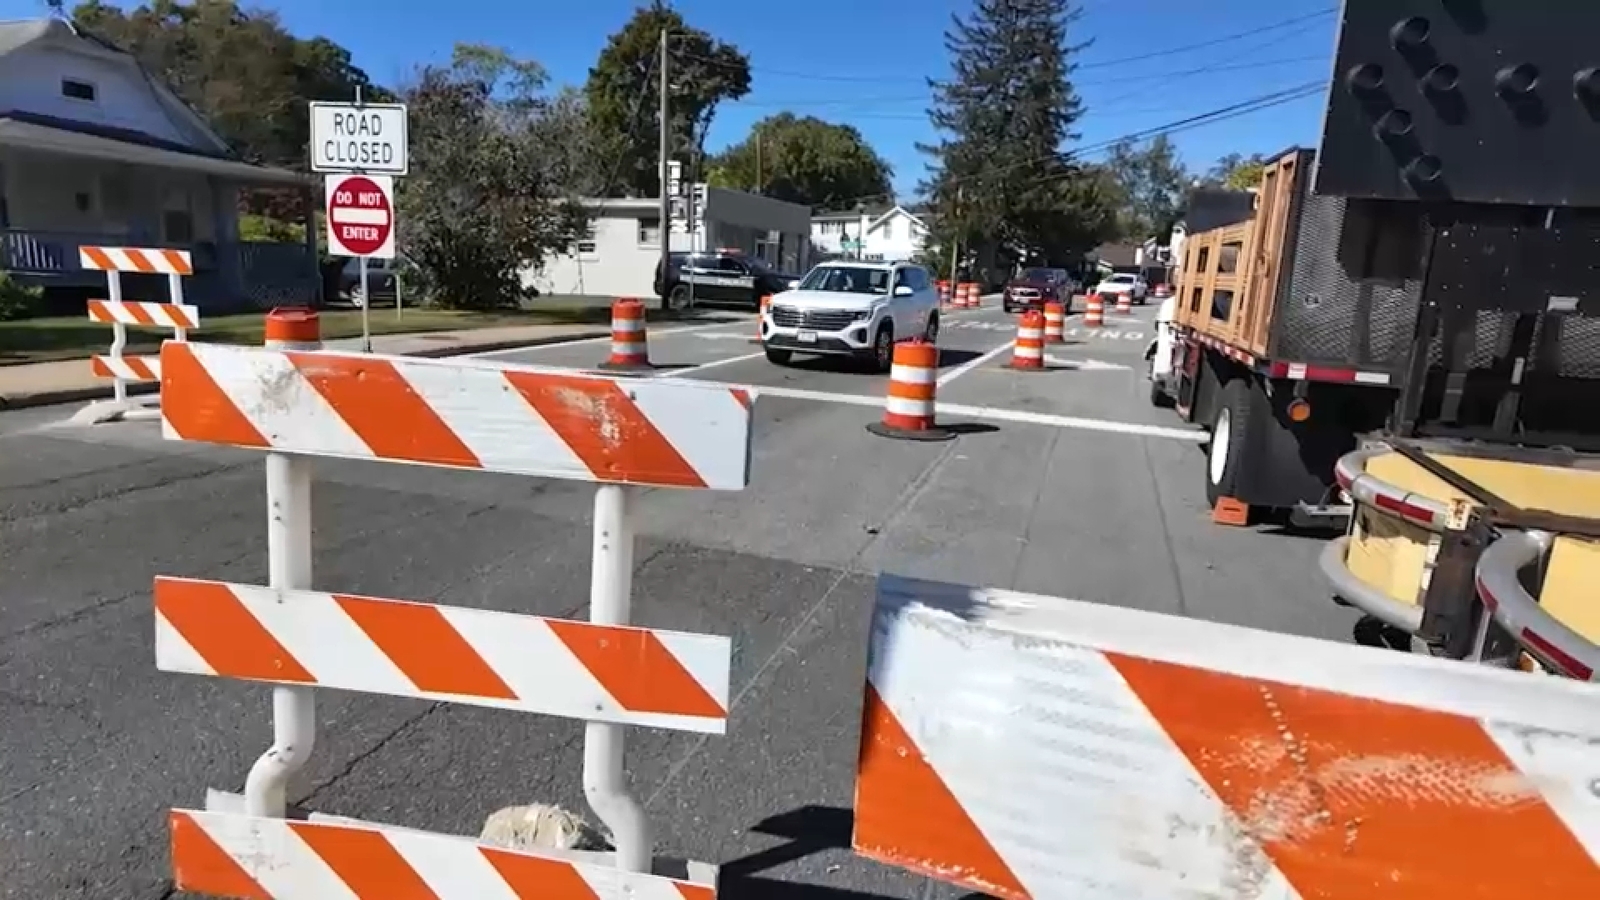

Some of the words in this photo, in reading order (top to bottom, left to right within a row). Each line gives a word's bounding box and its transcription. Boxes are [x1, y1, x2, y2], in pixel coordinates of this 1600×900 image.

[333, 113, 382, 136] ROAD
[324, 140, 393, 164] CLOSED
[336, 191, 352, 205] DO
[359, 192, 381, 206] NOT
[342, 226, 379, 241] ENTER
